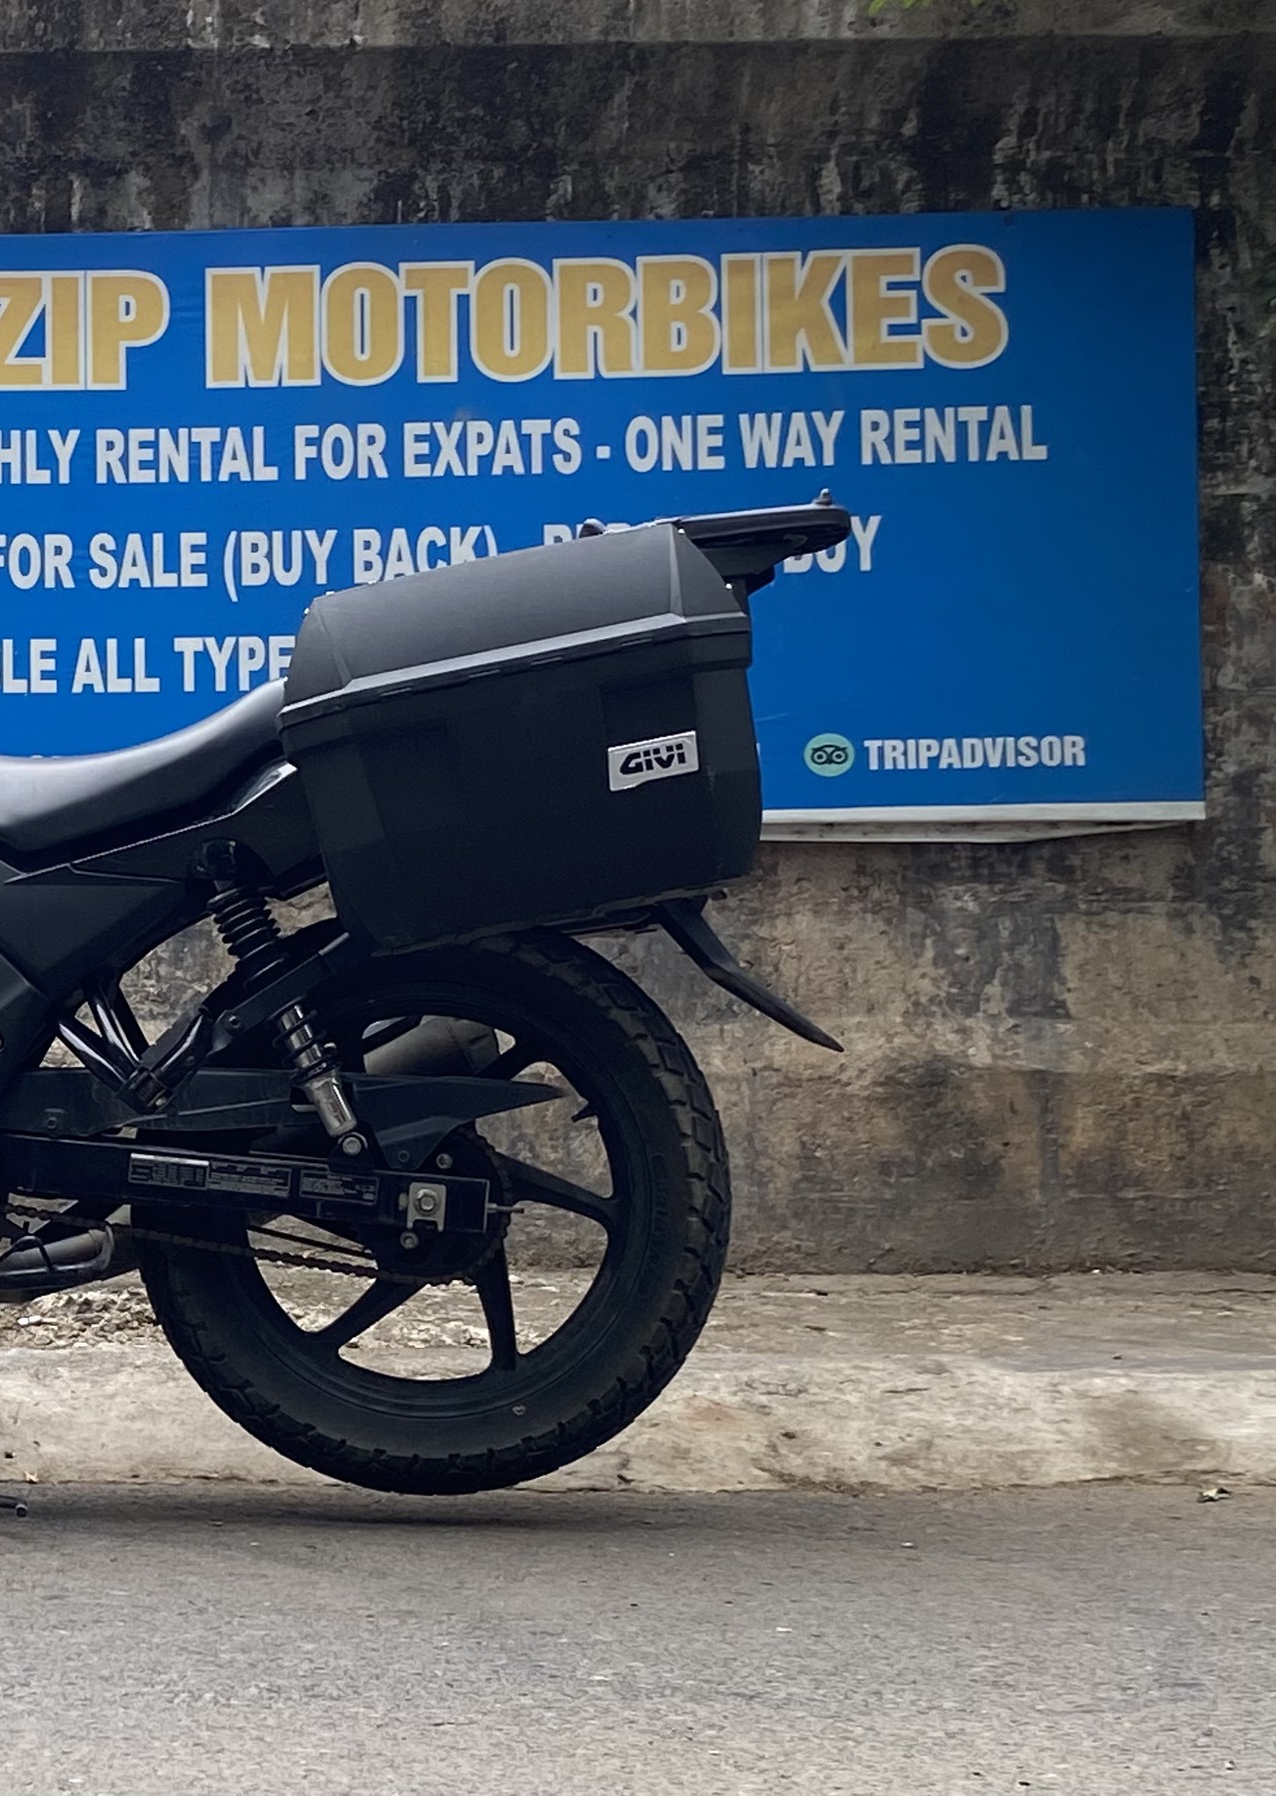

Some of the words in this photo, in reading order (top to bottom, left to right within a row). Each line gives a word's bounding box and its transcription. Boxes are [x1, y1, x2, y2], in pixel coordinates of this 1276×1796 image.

[205, 244, 1009, 389] MOTORBIKES
[96, 427, 279, 484] RENTAL
[294, 423, 389, 481] FOR
[403, 417, 582, 478] EXPATS
[596, 445, 611, 459] -
[625, 414, 725, 473] ONE
[739, 410, 845, 469] WAY
[861, 405, 1047, 465] RENTAL
[88, 532, 208, 589] SALE
[223, 530, 338, 602] (BUY
[71, 637, 160, 694] ALL
[173, 635, 296, 693] TYPE
[620, 743, 686, 775] GIVI
[863, 735, 1085, 770] TRIPADVISOR
